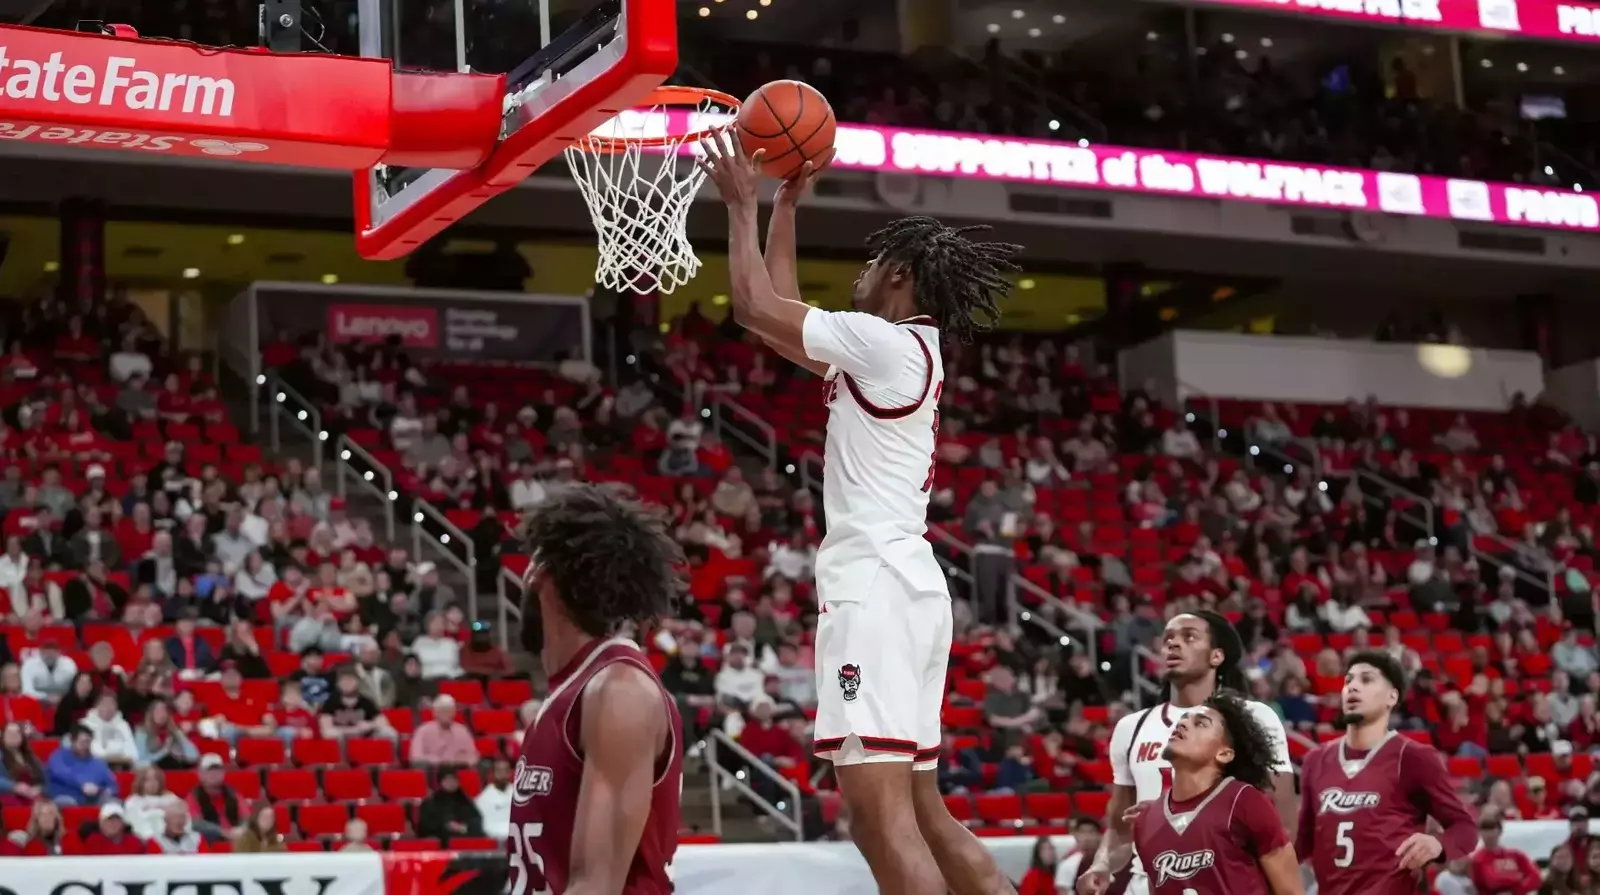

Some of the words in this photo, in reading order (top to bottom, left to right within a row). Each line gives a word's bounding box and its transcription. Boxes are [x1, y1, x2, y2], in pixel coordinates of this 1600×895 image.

[891, 131, 1099, 184] SUPPORTER
[1101, 151, 1137, 187] of
[1139, 154, 1194, 192] the
[1196, 157, 1367, 207] WOLFPACK
[1504, 187, 1599, 228] PROUD
[335, 309, 431, 339] Lenovo
[1136, 741, 1163, 763] NC
[1333, 821, 1355, 868] 5
